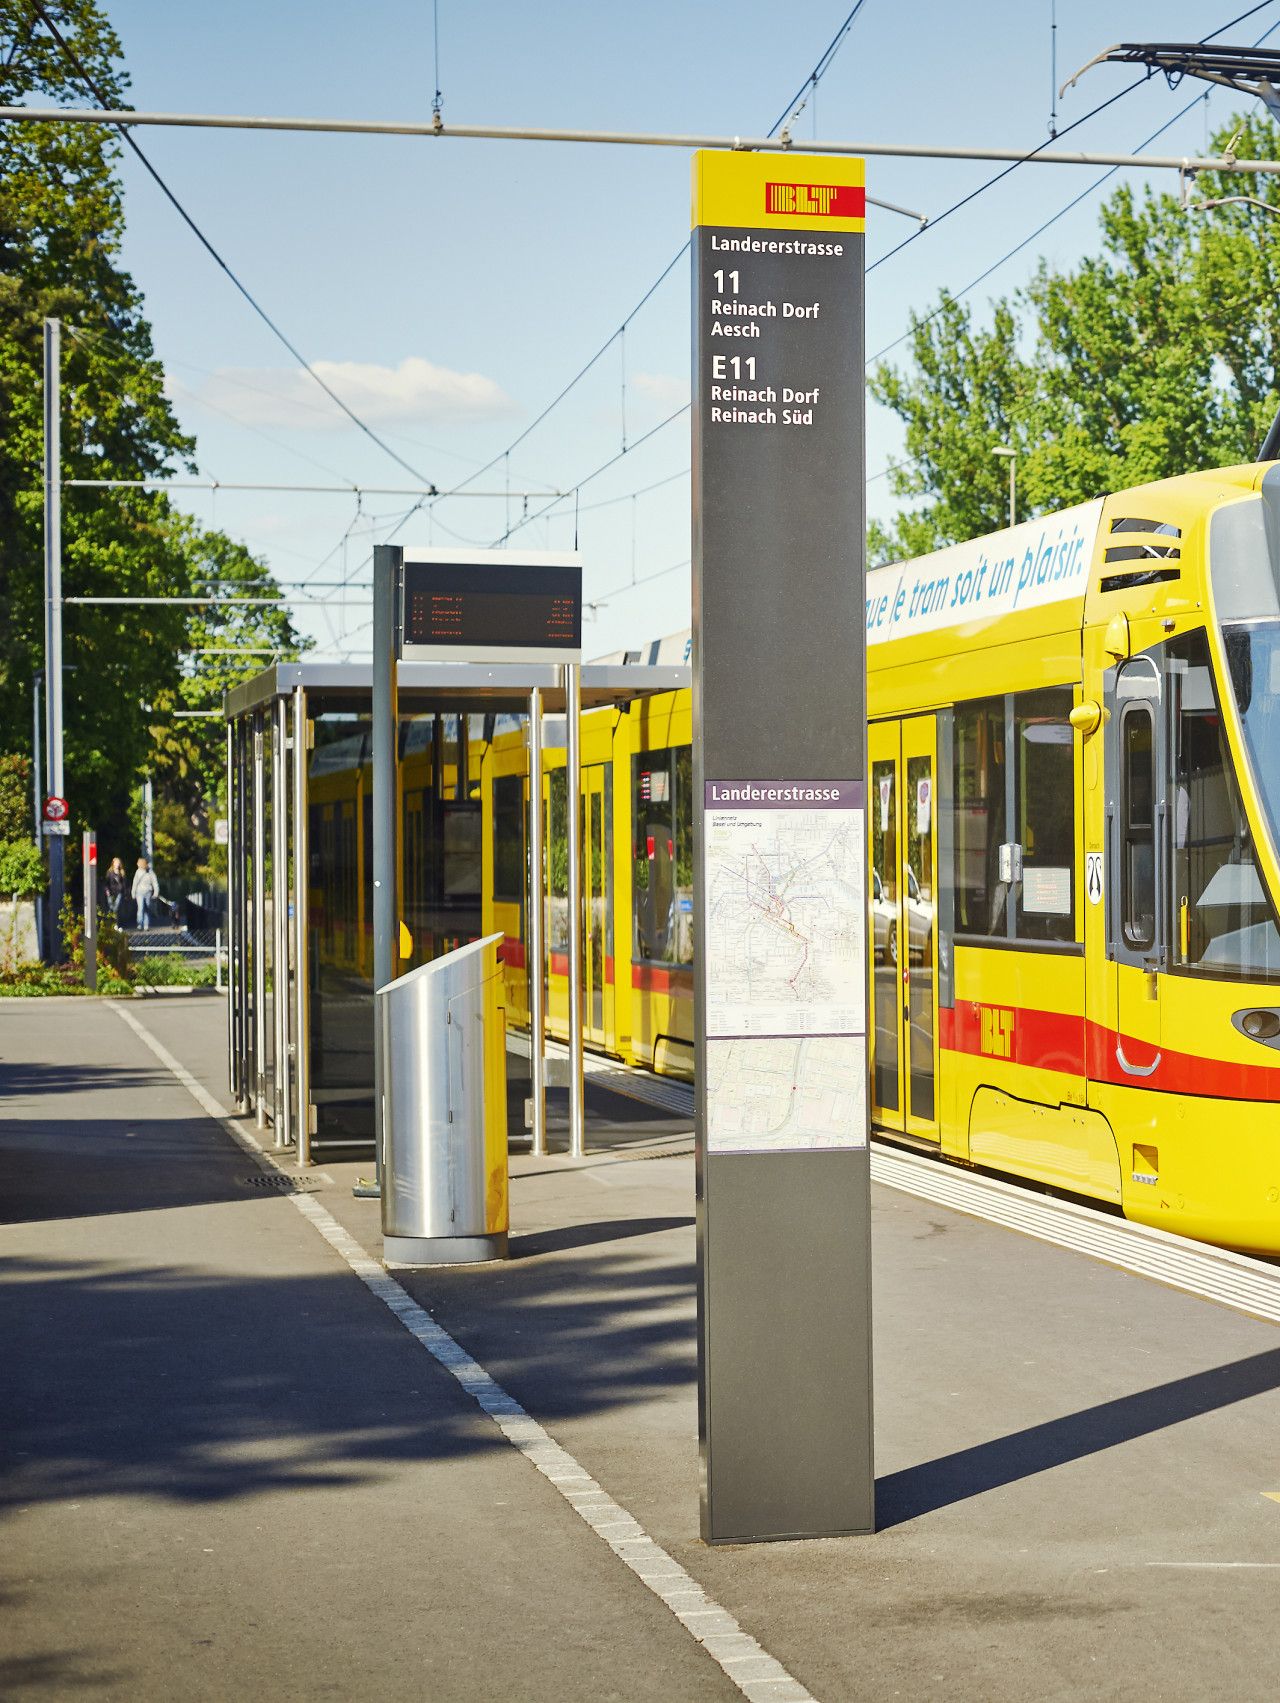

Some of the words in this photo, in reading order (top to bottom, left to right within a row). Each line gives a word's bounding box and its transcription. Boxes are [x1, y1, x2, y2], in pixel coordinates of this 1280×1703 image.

[770, 184, 837, 214] BLT
[711, 235, 844, 256] Landererstrasse
[713, 269, 739, 294] 11
[711, 300, 777, 317] Reinach
[782, 302, 820, 319] Dorf
[711, 321, 760, 338] Aesch
[712, 355, 756, 381] E11
[711, 386, 777, 403] Reinach
[782, 388, 820, 404] Dorf
[711, 407, 777, 424] Reinach
[782, 408, 813, 426] Süd
[889, 576, 906, 622] le
[908, 576, 949, 618] tram
[950, 553, 988, 608] soit
[988, 557, 1015, 597] un
[1012, 524, 1084, 608] plaisir.
[712, 784, 840, 801] Landererstrasse
[980, 1007, 1014, 1058] BLT
